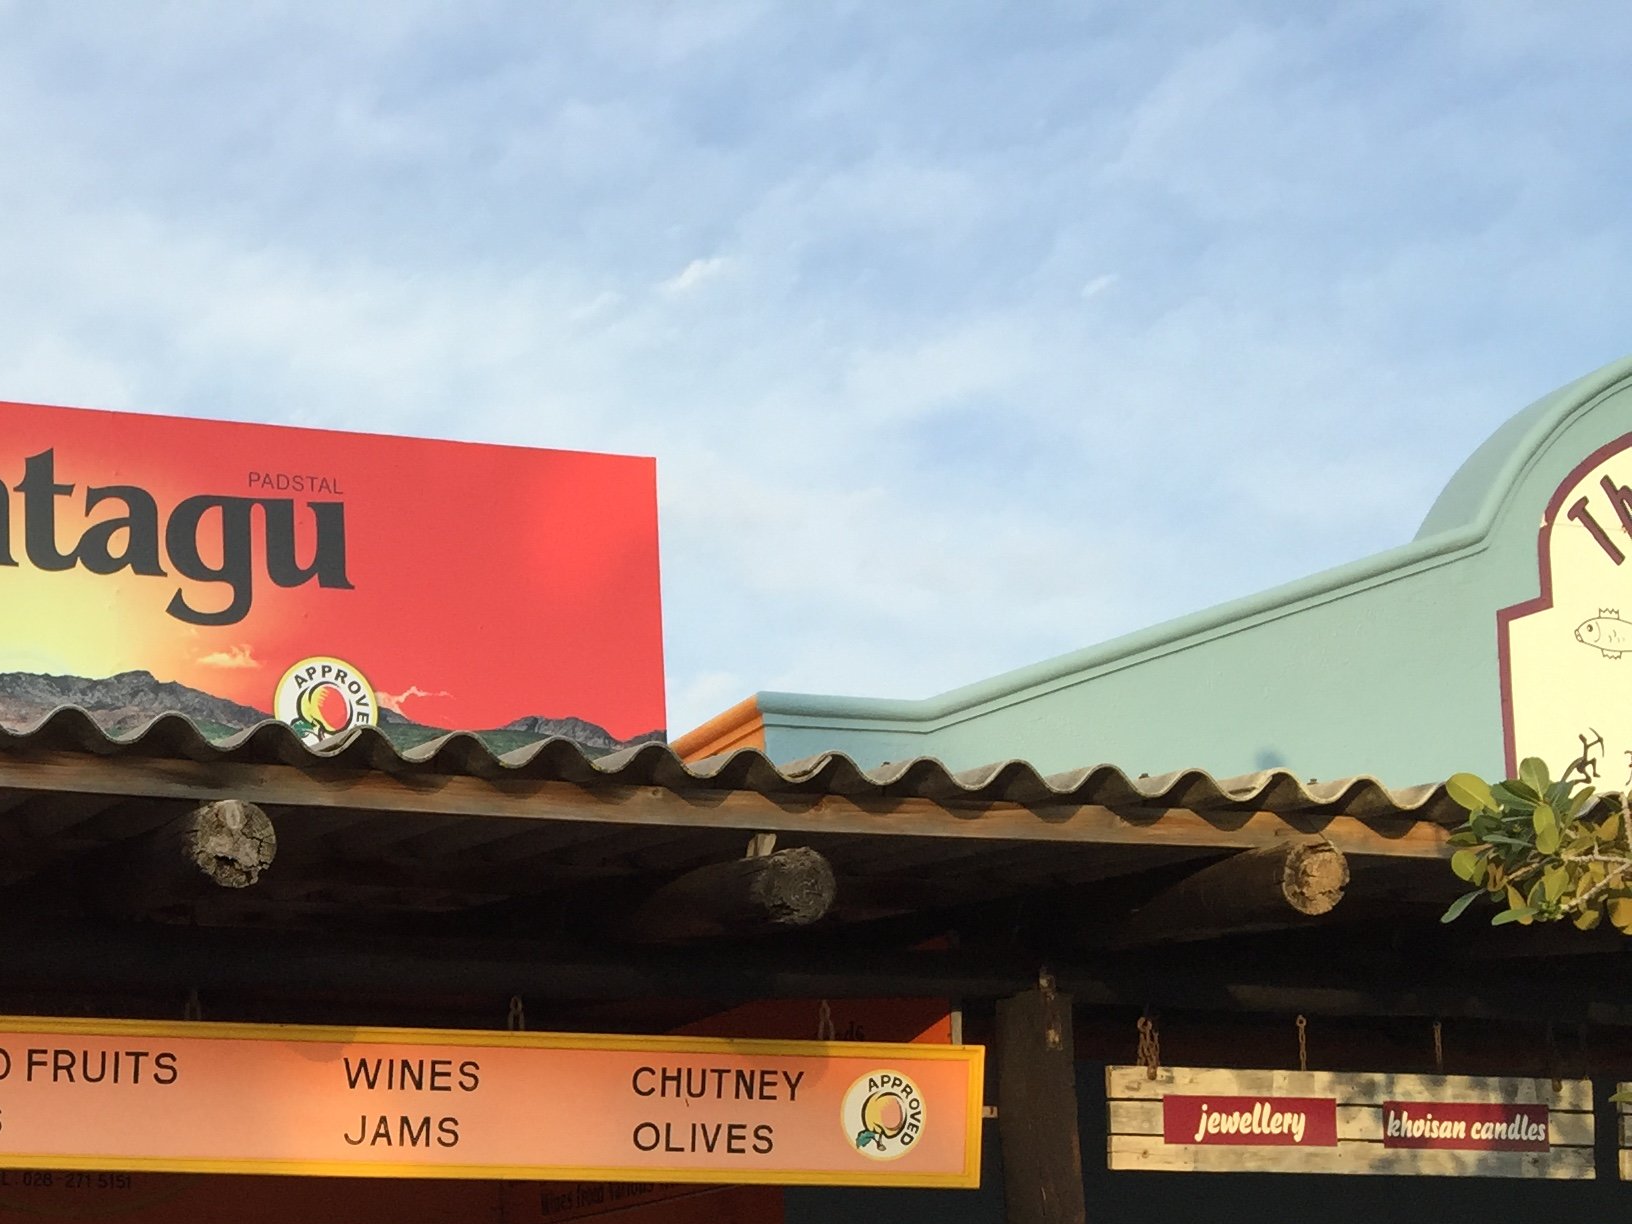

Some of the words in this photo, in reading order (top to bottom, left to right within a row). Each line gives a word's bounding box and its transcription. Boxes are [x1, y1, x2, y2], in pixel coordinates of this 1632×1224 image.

[247, 470, 345, 497] PADSTAL
[294, 664, 370, 725] APPROVE
[26, 1048, 179, 1085] FRUITS
[343, 1057, 480, 1092] WINES
[632, 1066, 805, 1102] CHUTNEY
[868, 1074, 922, 1146] APPROVED
[1194, 1102, 1306, 1142] jewellery
[1386, 1110, 1466, 1140] khoisan
[1470, 1111, 1546, 1141] candles
[343, 1115, 460, 1148] JAMS
[632, 1121, 775, 1154] OLIVES
